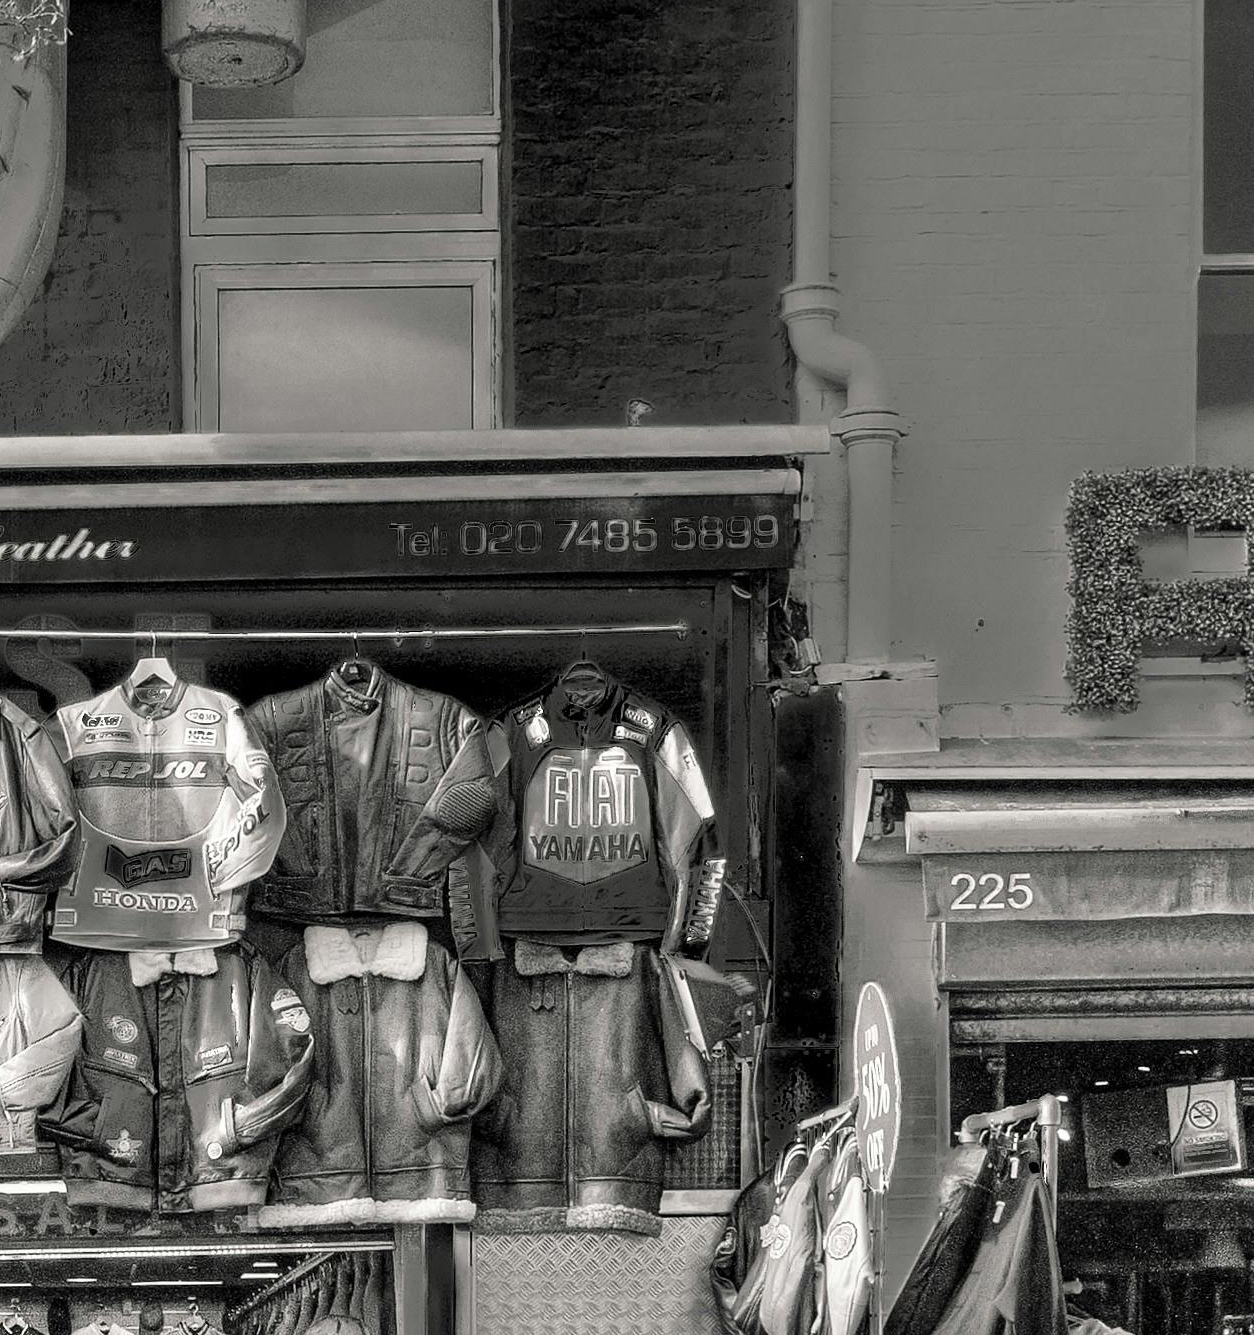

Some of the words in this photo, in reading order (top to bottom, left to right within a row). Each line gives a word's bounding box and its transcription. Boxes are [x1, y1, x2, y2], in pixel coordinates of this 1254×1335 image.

[388, 521, 449, 558] Tel:
[459, 520, 543, 556] 020
[553, 517, 659, 554] 7485
[670, 514, 780, 551] 5899
[544, 766, 641, 828] FIAT
[122, 852, 190, 883] GAS
[529, 833, 647, 862] YAMAHA
[93, 887, 198, 913] HONDA
[686, 858, 727, 943] YAMAHA
[949, 872, 1034, 911] 225
[861, 1051, 891, 1131] 50%
[866, 1128, 885, 1173] OFF
